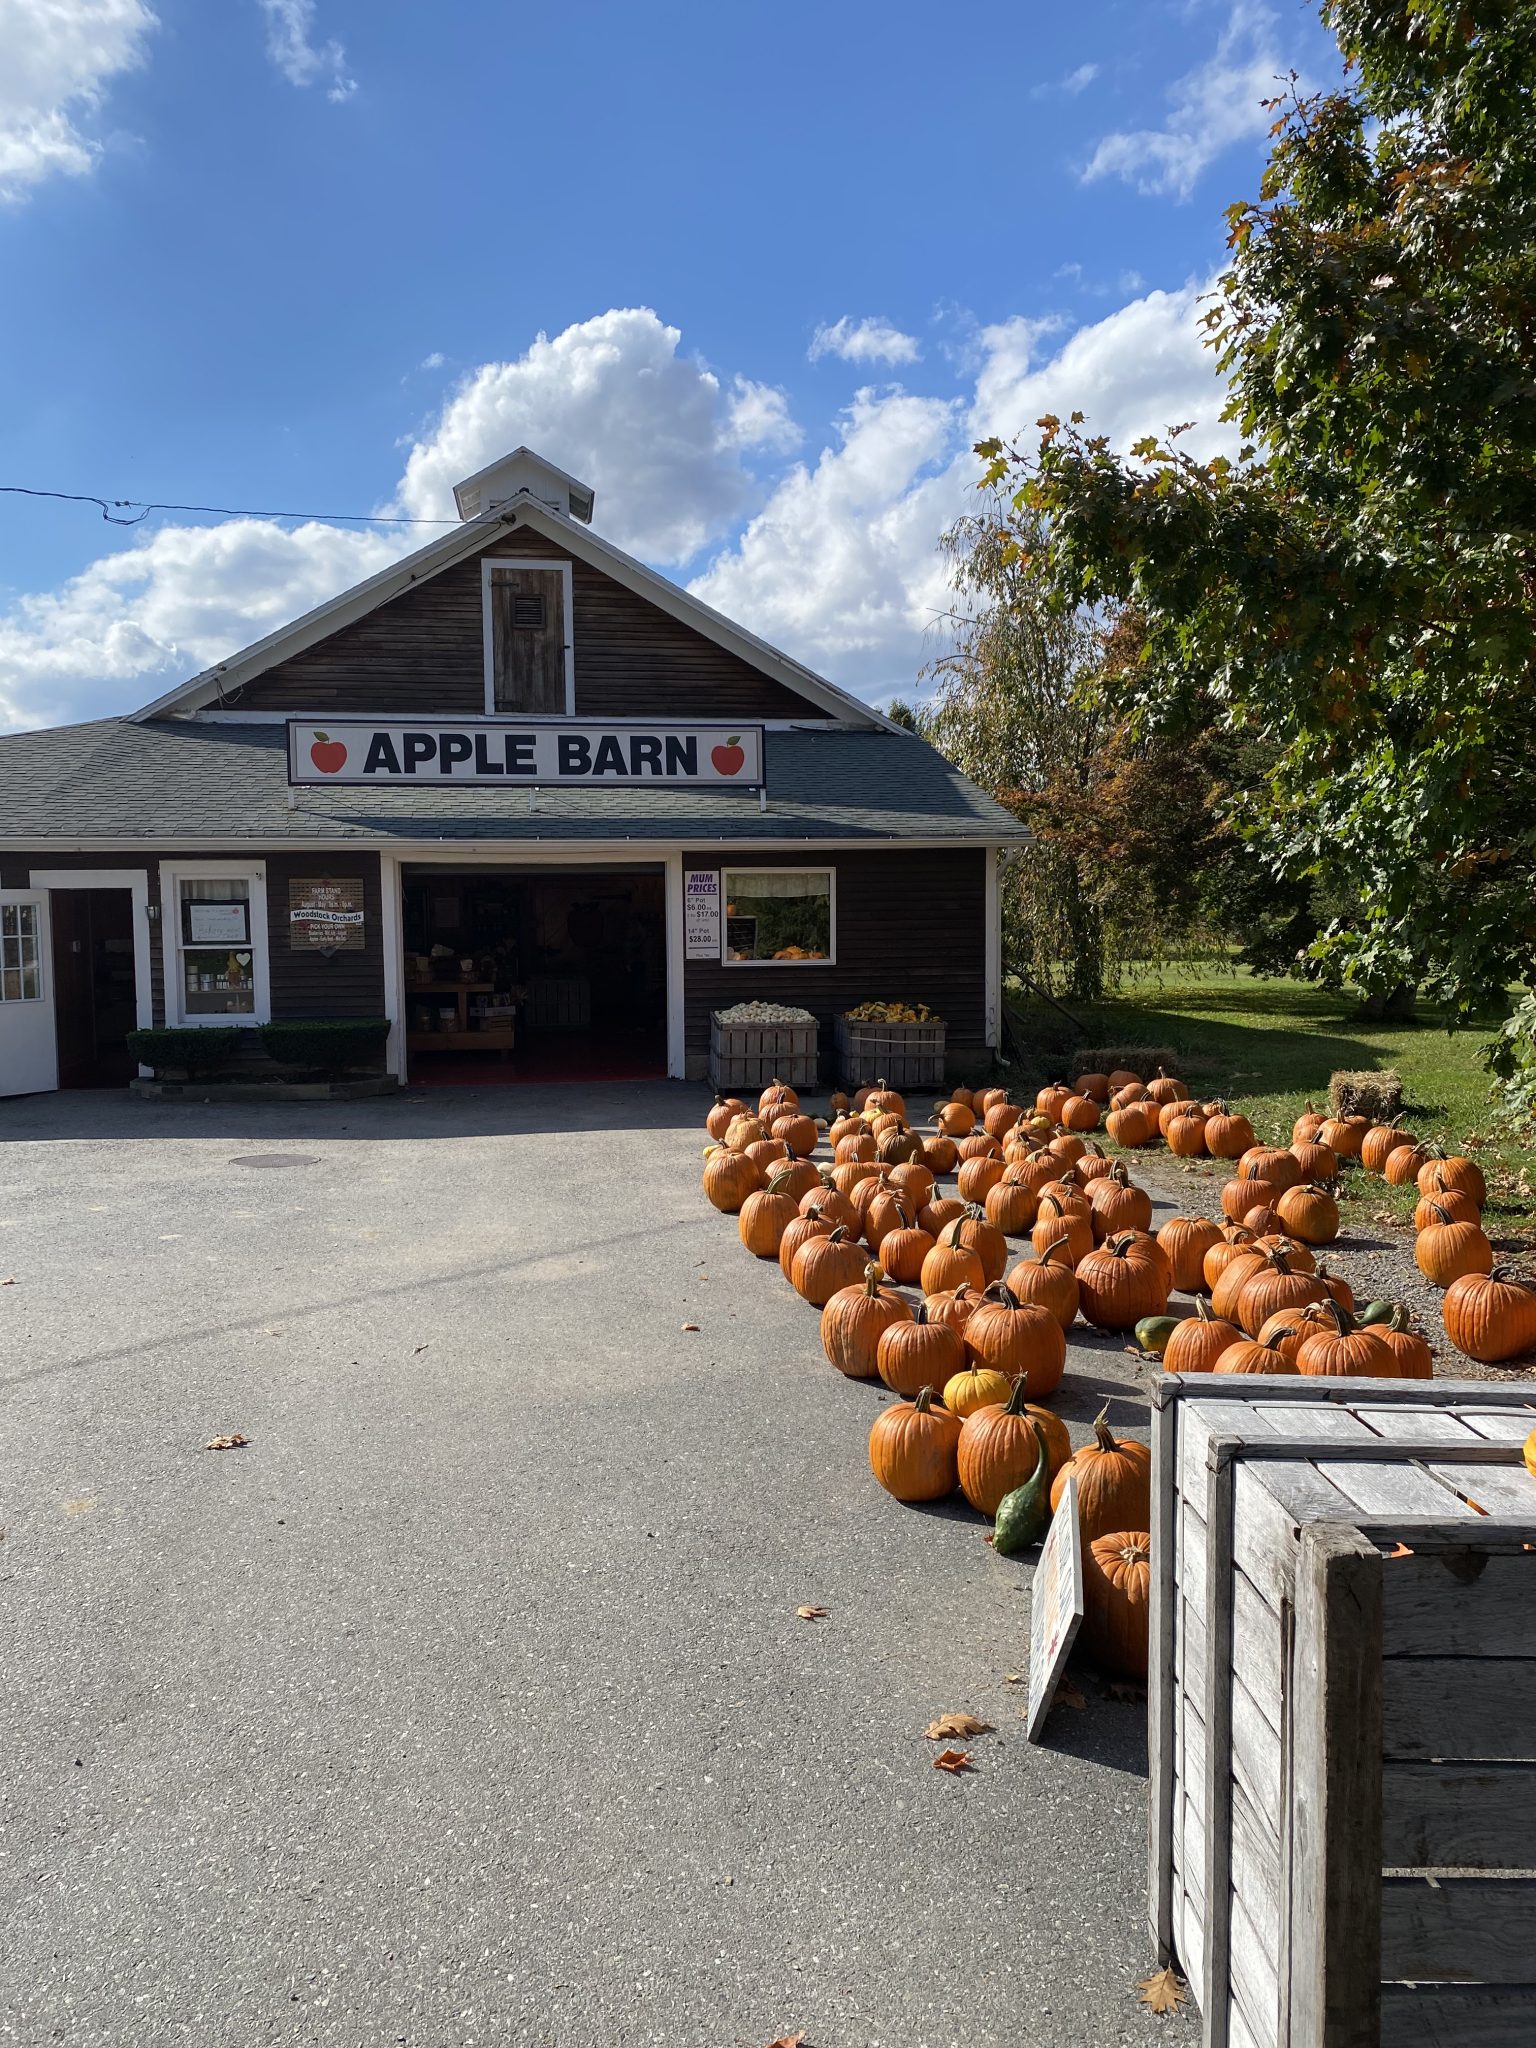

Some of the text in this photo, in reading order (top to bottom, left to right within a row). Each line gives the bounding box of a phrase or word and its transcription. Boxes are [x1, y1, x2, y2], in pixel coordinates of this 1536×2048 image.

[363, 732, 698, 776] APPLE BARN
[690, 873, 713, 883] MUM
[687, 883, 718, 893] PRICES
[293, 911, 361, 922] Woodstock Orchards
